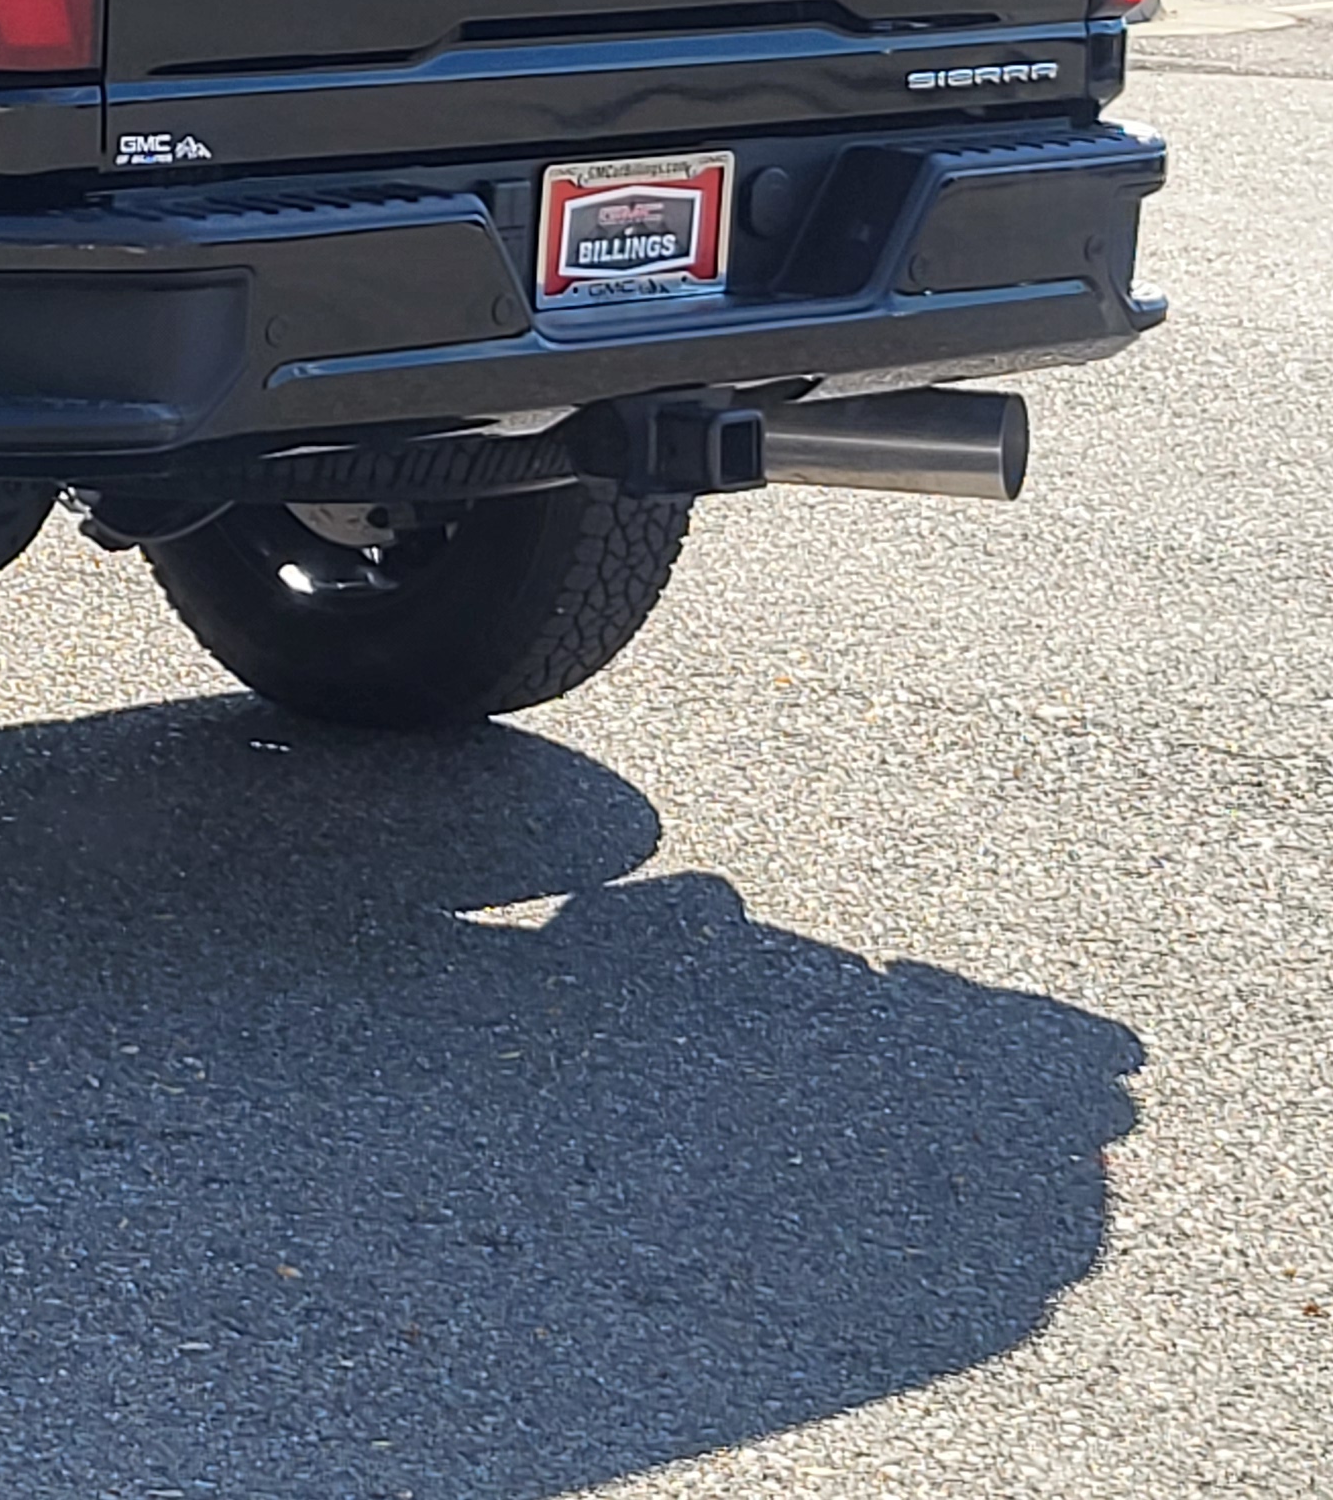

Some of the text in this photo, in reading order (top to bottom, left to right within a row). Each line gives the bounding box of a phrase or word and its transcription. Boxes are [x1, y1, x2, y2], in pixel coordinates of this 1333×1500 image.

[906, 61, 1058, 90] SIERRA
[120, 135, 171, 153] GMC
[579, 232, 676, 264] BILLINGS
[589, 280, 635, 297] GMC
